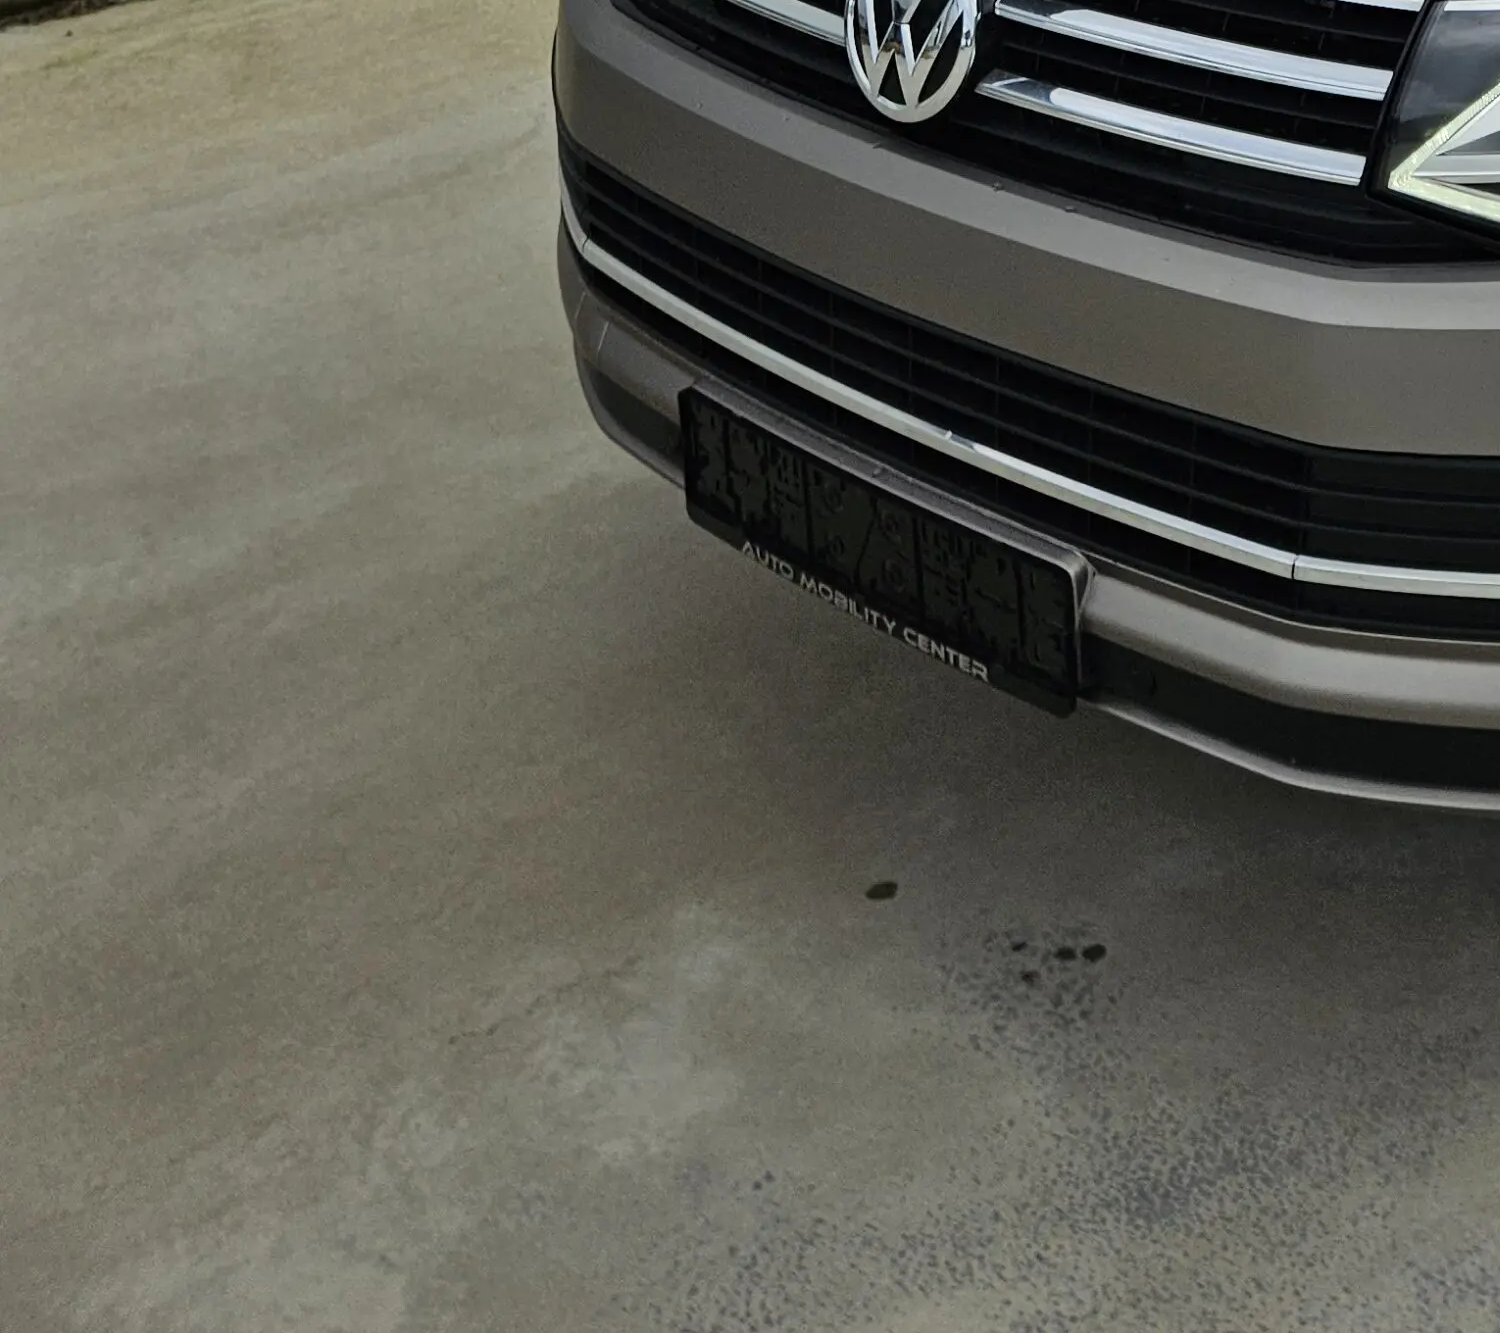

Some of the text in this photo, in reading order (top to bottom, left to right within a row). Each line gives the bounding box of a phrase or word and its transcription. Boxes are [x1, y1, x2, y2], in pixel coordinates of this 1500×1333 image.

[742, 540, 989, 683] AUTO MOBILITY CENTER
